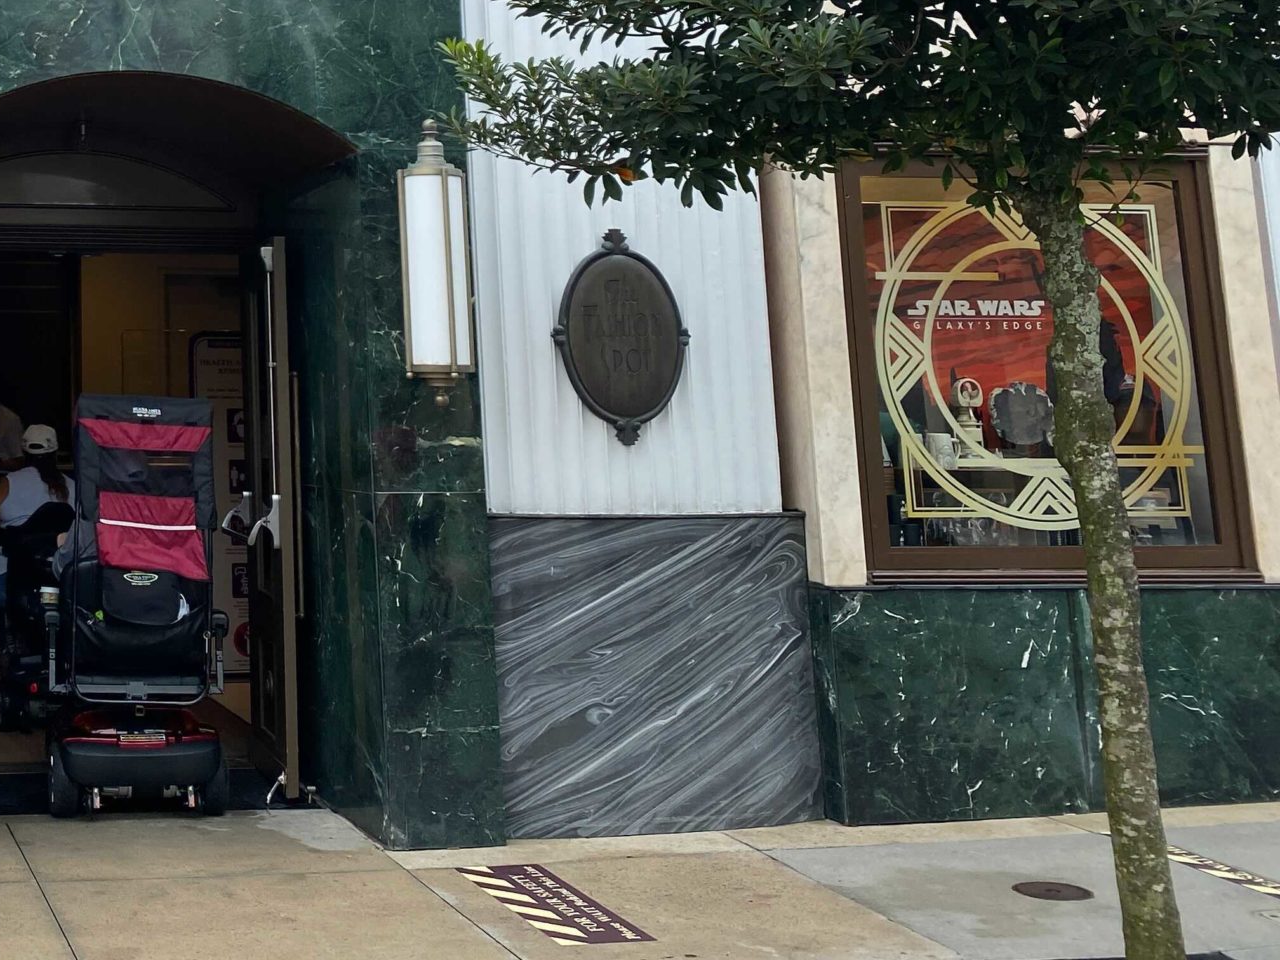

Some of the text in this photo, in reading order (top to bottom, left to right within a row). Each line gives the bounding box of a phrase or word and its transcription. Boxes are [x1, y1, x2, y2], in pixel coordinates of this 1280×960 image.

[977, 300, 1045, 317] WARS
[913, 320, 1043, 330] GLAXY'S EDGE
[508, 874, 606, 932] FOR YOUR SAFETY
